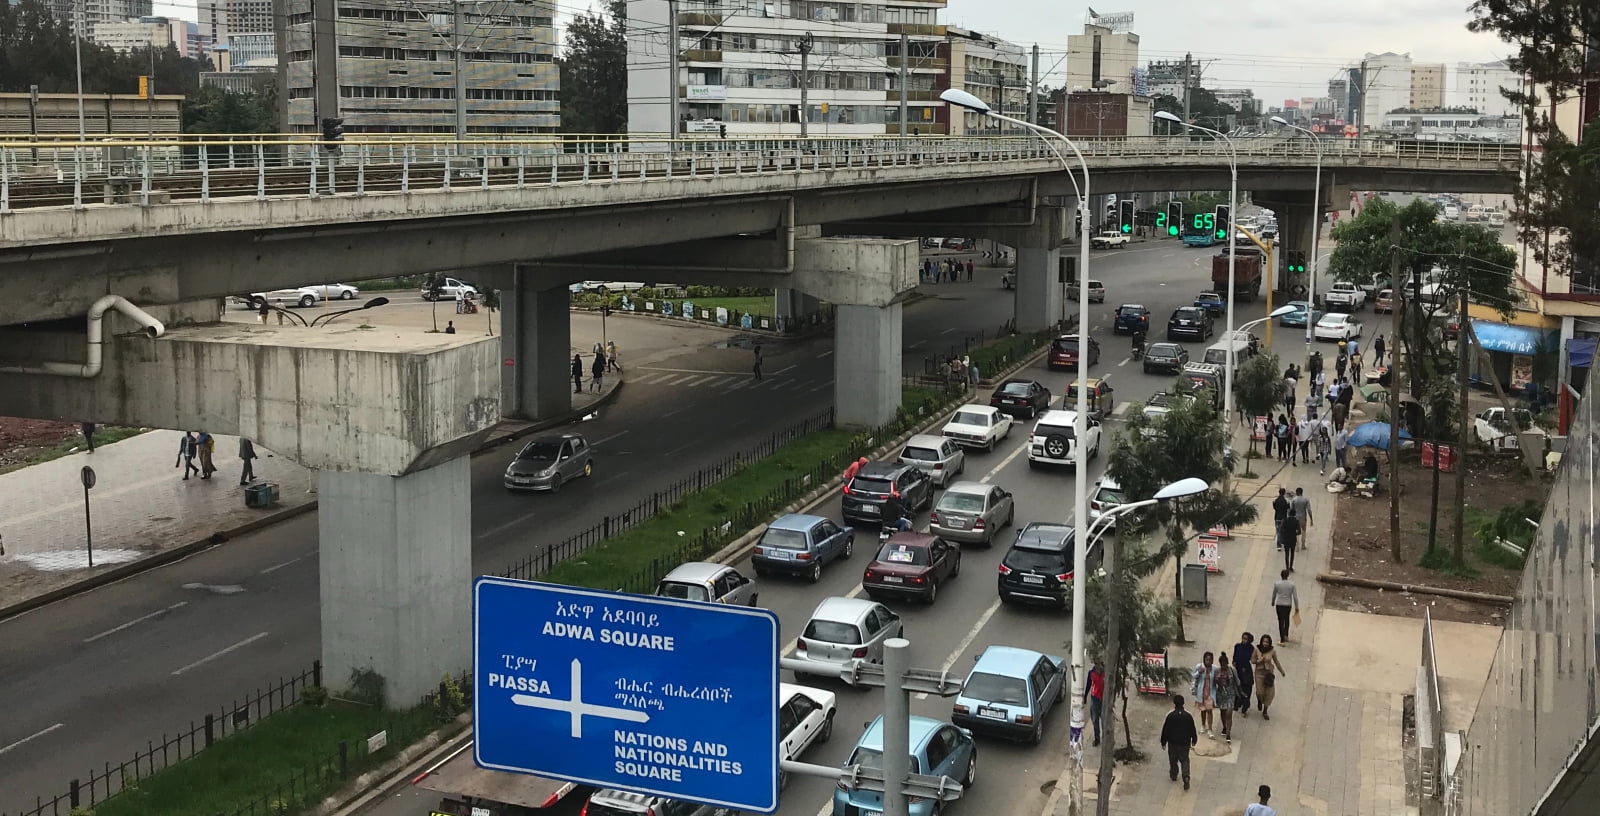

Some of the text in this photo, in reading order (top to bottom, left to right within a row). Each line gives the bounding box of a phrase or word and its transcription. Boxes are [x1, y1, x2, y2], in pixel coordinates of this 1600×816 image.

[1194, 214, 1213, 229] 65
[556, 601, 660, 628] አድዋ አደባባይ
[541, 621, 675, 651] ADWA SQUARE
[488, 672, 551, 695] PIASSA
[614, 677, 733, 704] ብሔር ብሔረሰቦች
[614, 729, 728, 757] NATIONS AND
[614, 745, 743, 775] NATIONALITIES
[614, 760, 682, 782] SQUARE
